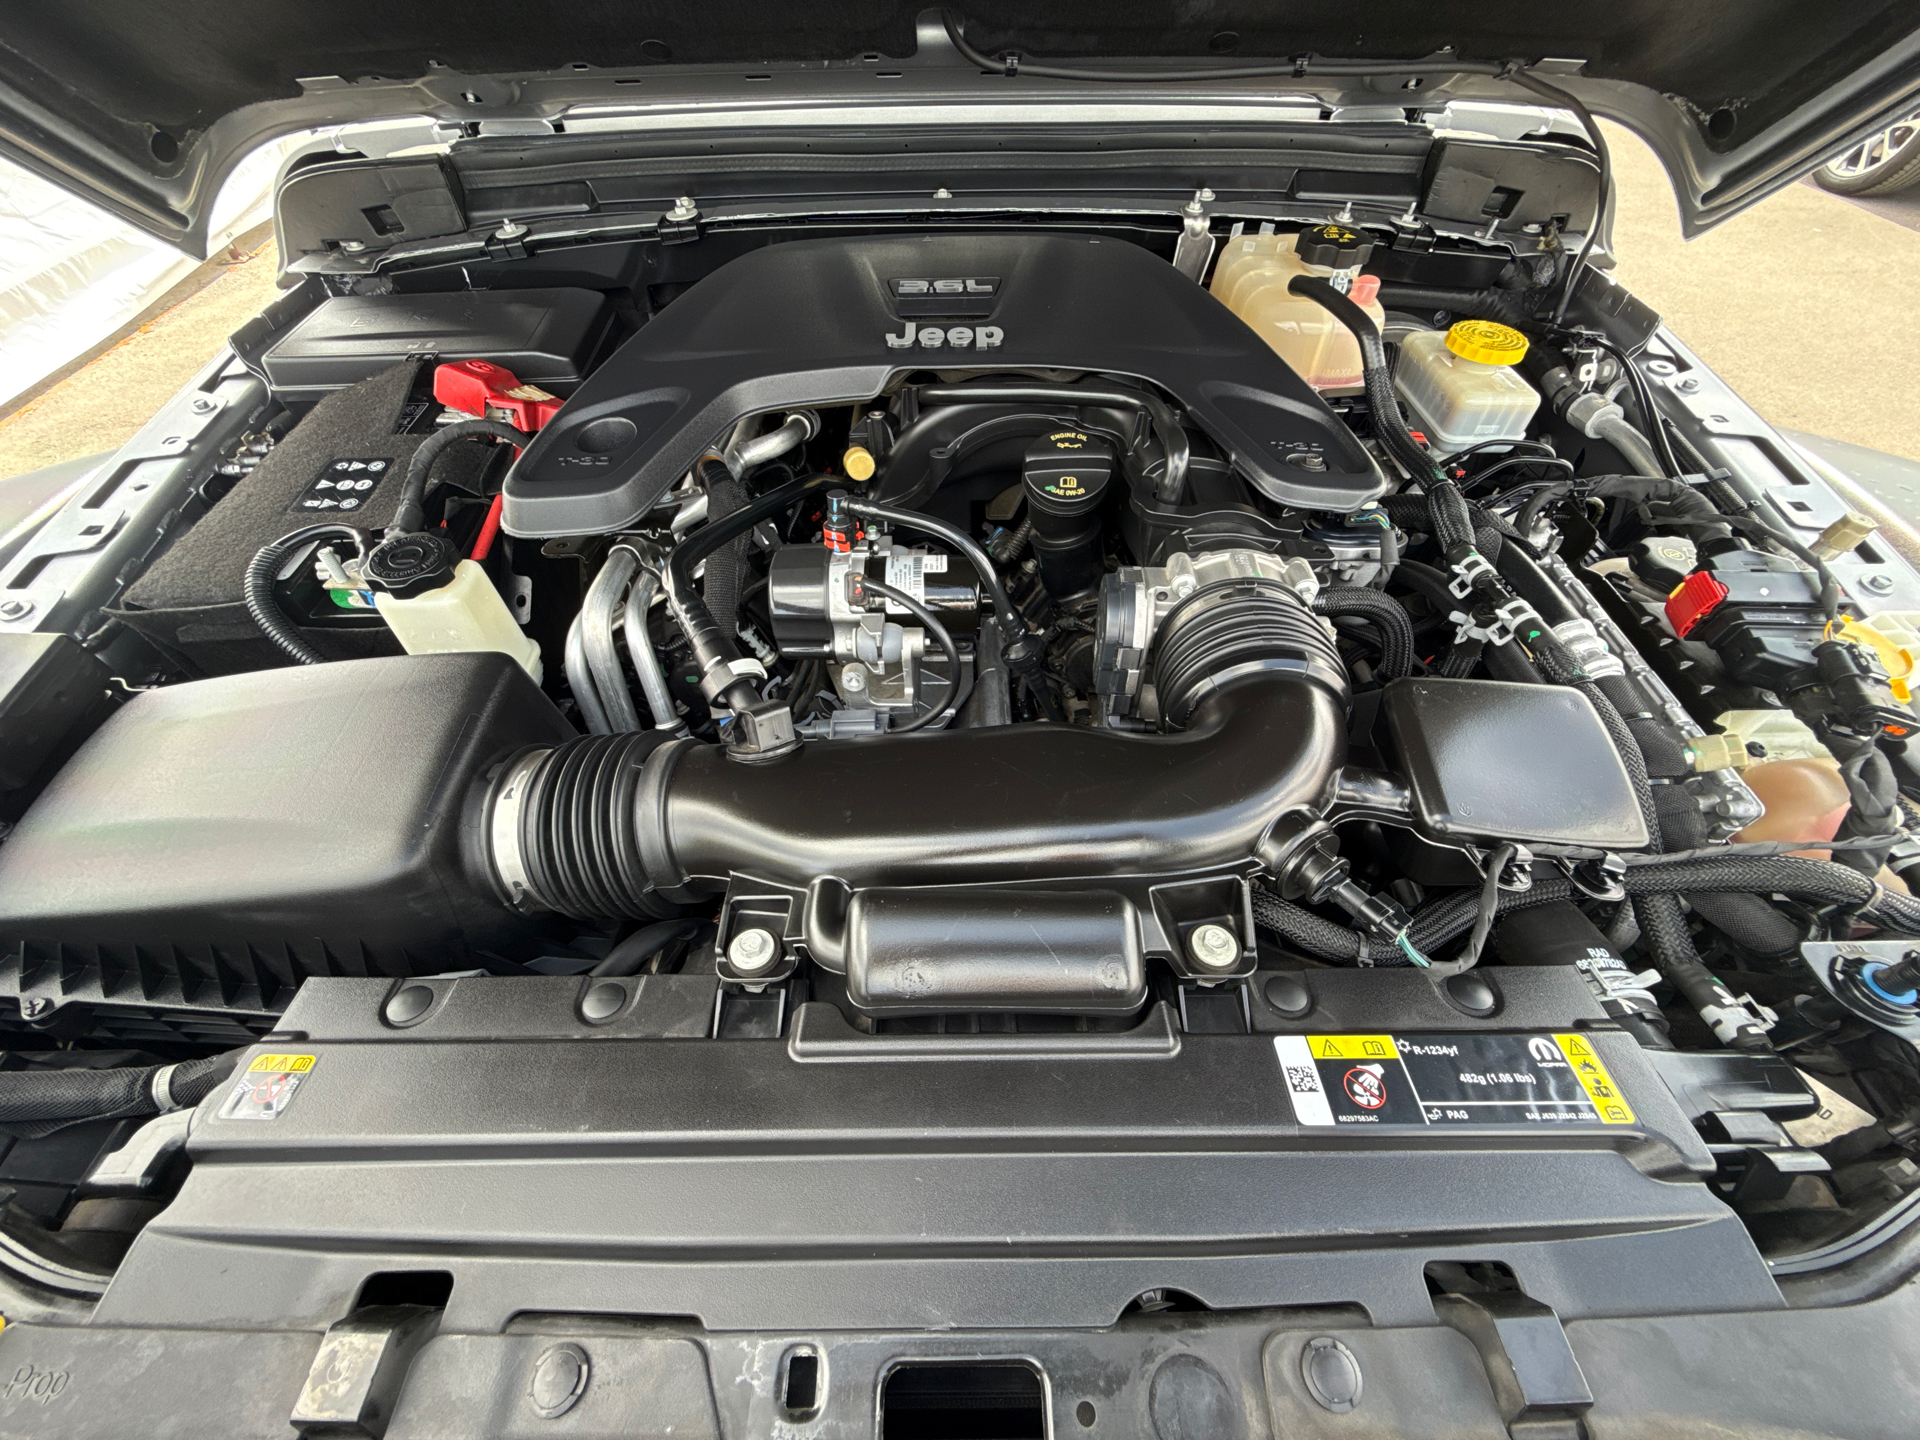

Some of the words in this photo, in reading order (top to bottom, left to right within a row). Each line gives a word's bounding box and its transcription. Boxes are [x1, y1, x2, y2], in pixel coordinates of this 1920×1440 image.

[898, 279, 993, 294] 3.6L
[885, 322, 1004, 351] Jeep
[1050, 432, 1076, 441] ENGINE
[1077, 433, 1088, 442] OIL
[1586, 947, 1610, 958] RAD
[1412, 1045, 1459, 1057] R-1234yf
[1460, 1073, 1487, 1085] 482g
[1487, 1073, 1513, 1085] (1.06
[1513, 1073, 1536, 1085] lbs)
[1446, 1110, 1469, 1119] PAG
[5, 1364, 70, 1405] Prop
